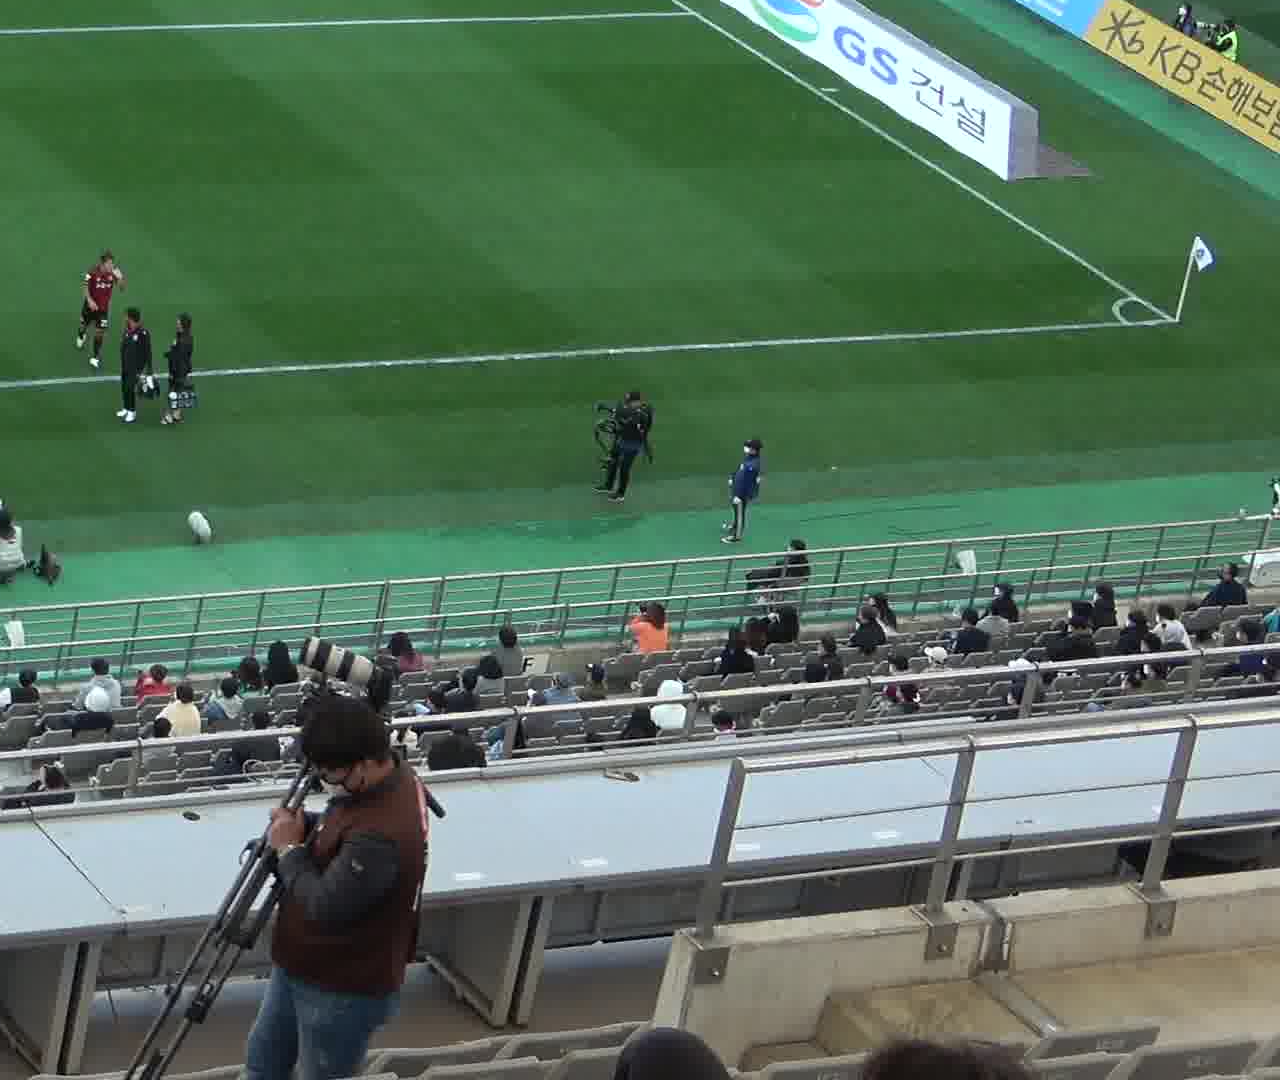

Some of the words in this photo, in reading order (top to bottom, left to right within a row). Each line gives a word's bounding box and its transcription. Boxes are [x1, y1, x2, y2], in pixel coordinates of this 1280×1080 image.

[833, 25, 899, 86] GS
[909, 68, 987, 144] 건설
[522, 657, 535, 672] F
